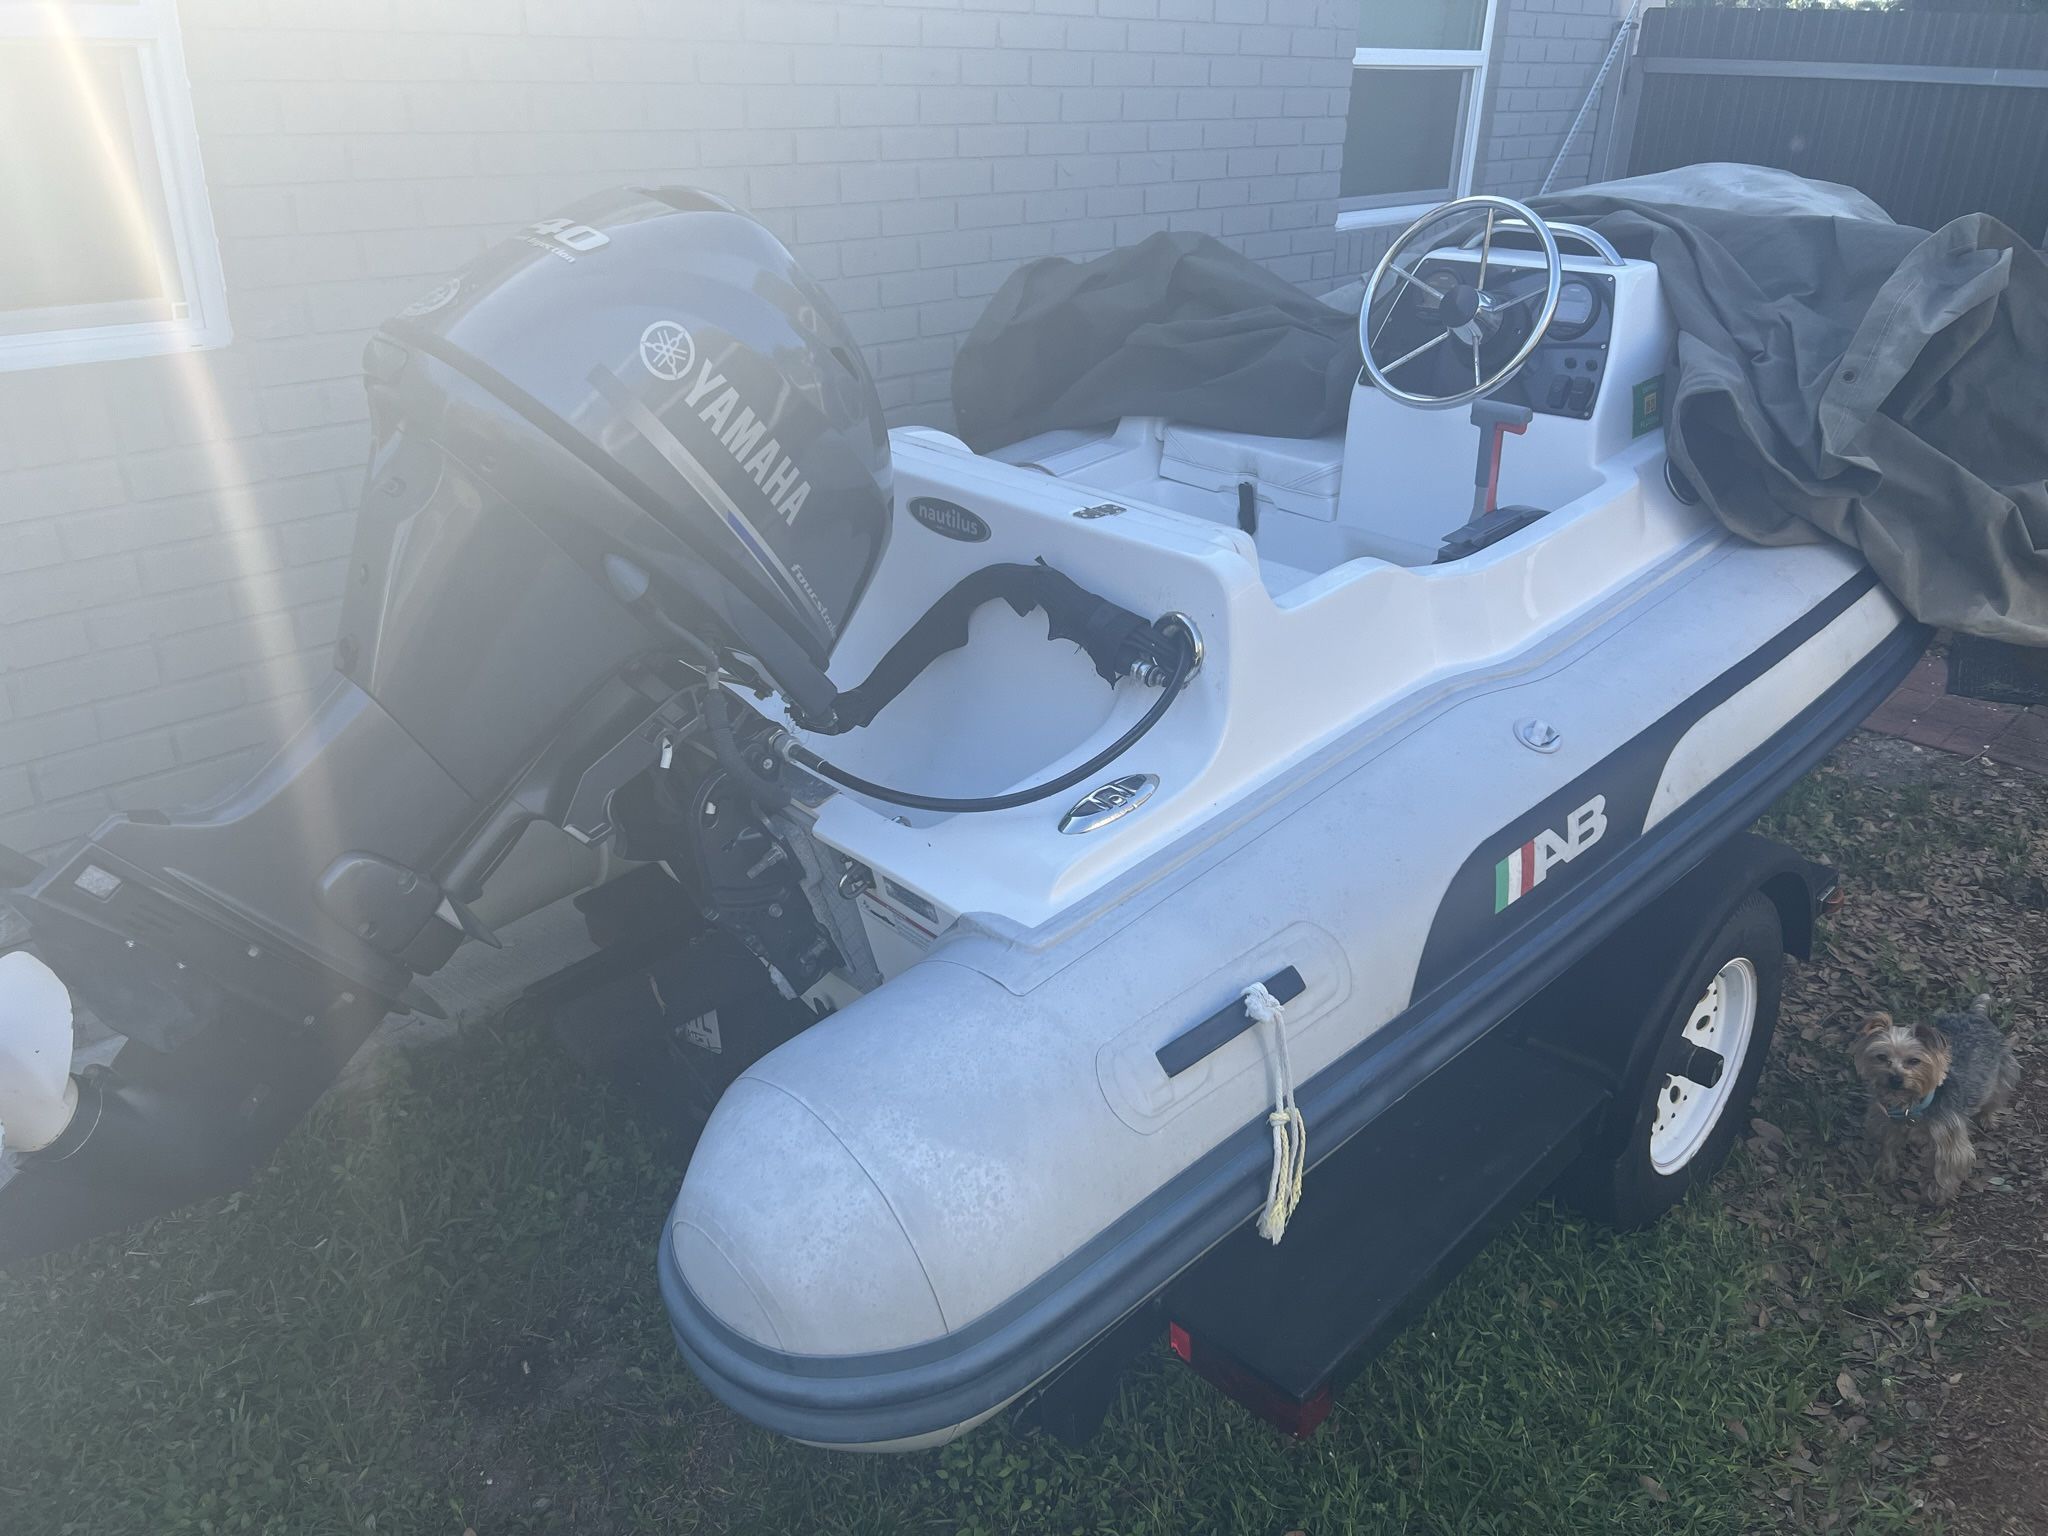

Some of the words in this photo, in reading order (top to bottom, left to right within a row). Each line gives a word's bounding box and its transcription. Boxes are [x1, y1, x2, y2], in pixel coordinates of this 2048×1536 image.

[528, 217, 610, 251] 40
[684, 357, 811, 527] YAMAHA
[918, 503, 978, 535] nautilus
[1533, 793, 1608, 887] AB
